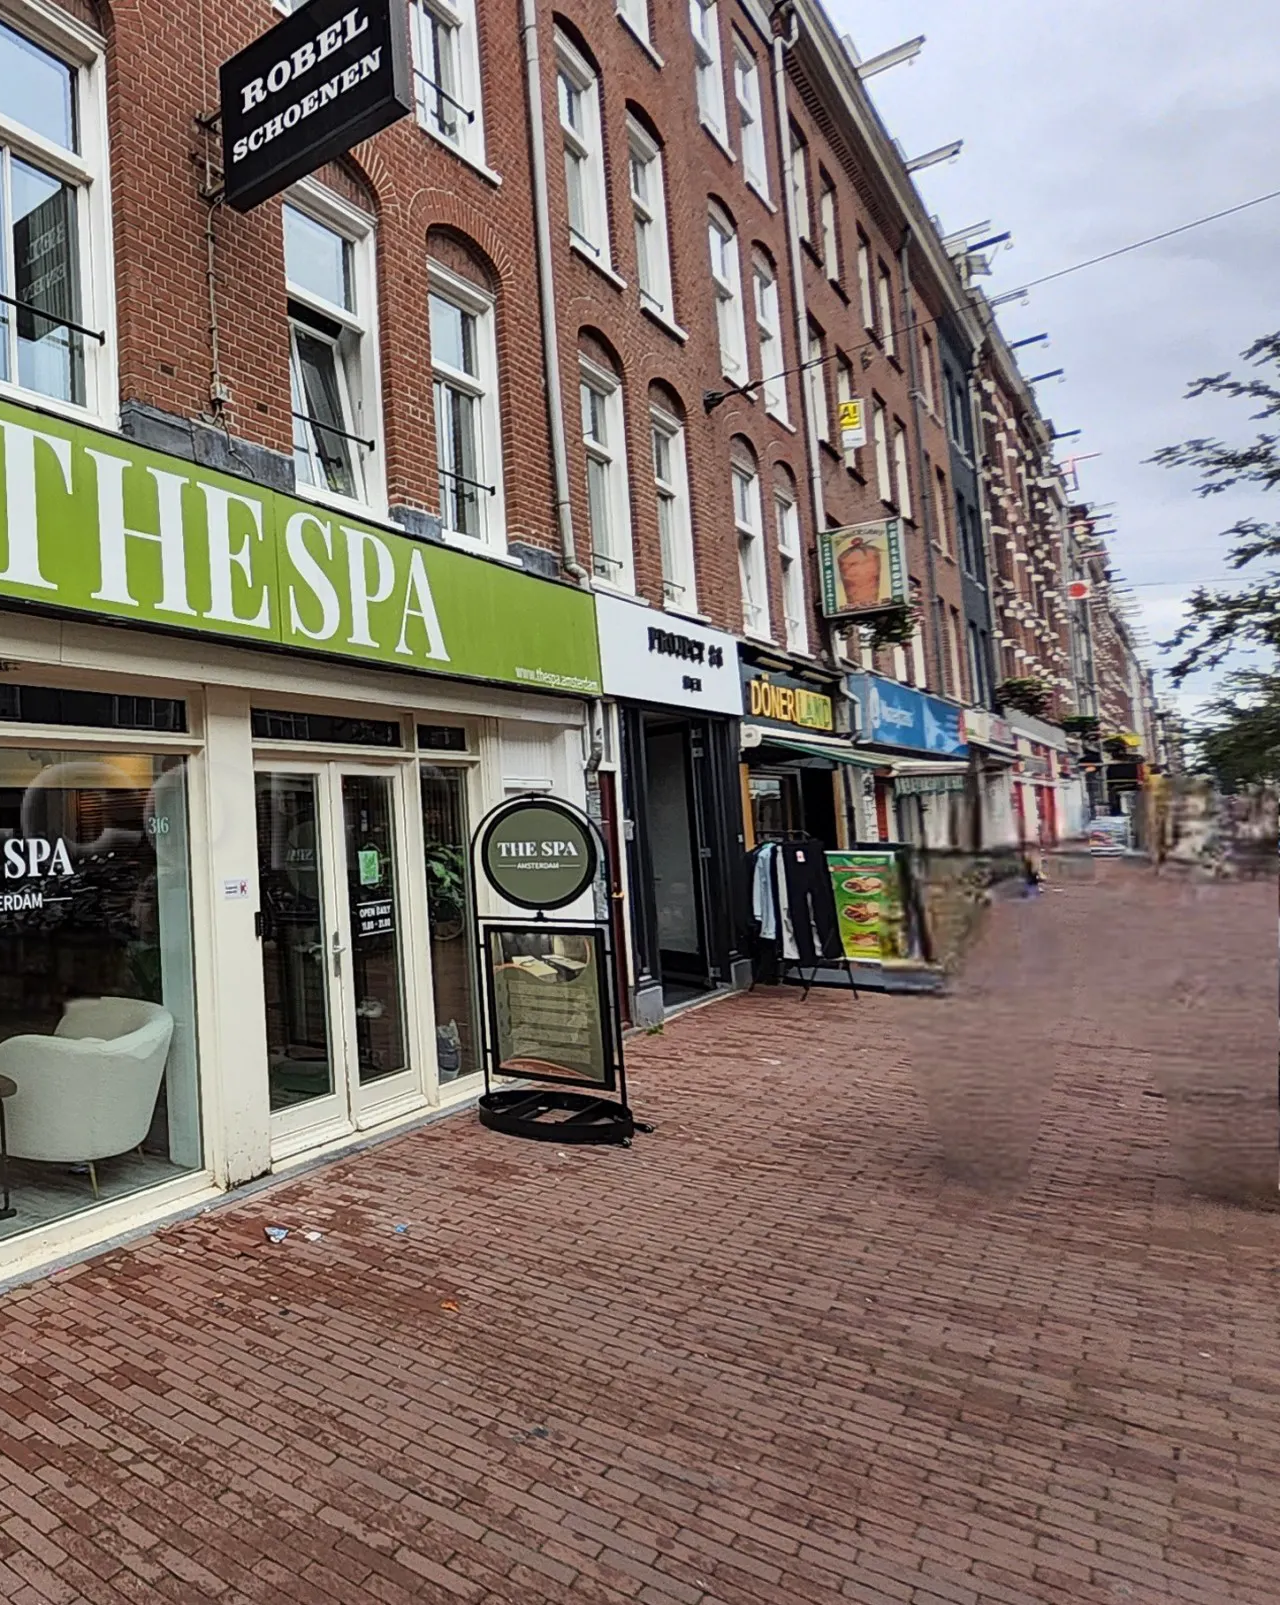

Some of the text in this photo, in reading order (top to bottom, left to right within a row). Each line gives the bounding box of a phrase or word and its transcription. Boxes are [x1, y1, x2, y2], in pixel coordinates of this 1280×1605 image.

[241, 7, 368, 114] ROBEL
[233, 46, 382, 164] SCHOENEN
[285, 512, 451, 662] SPA
[148, 816, 169, 835] 316
[4, 837, 75, 880] SPA
[497, 841, 578, 857] THE SPA
[517, 862, 559, 870] AMSTERDAM
[359, 907, 376, 918] OPEN
